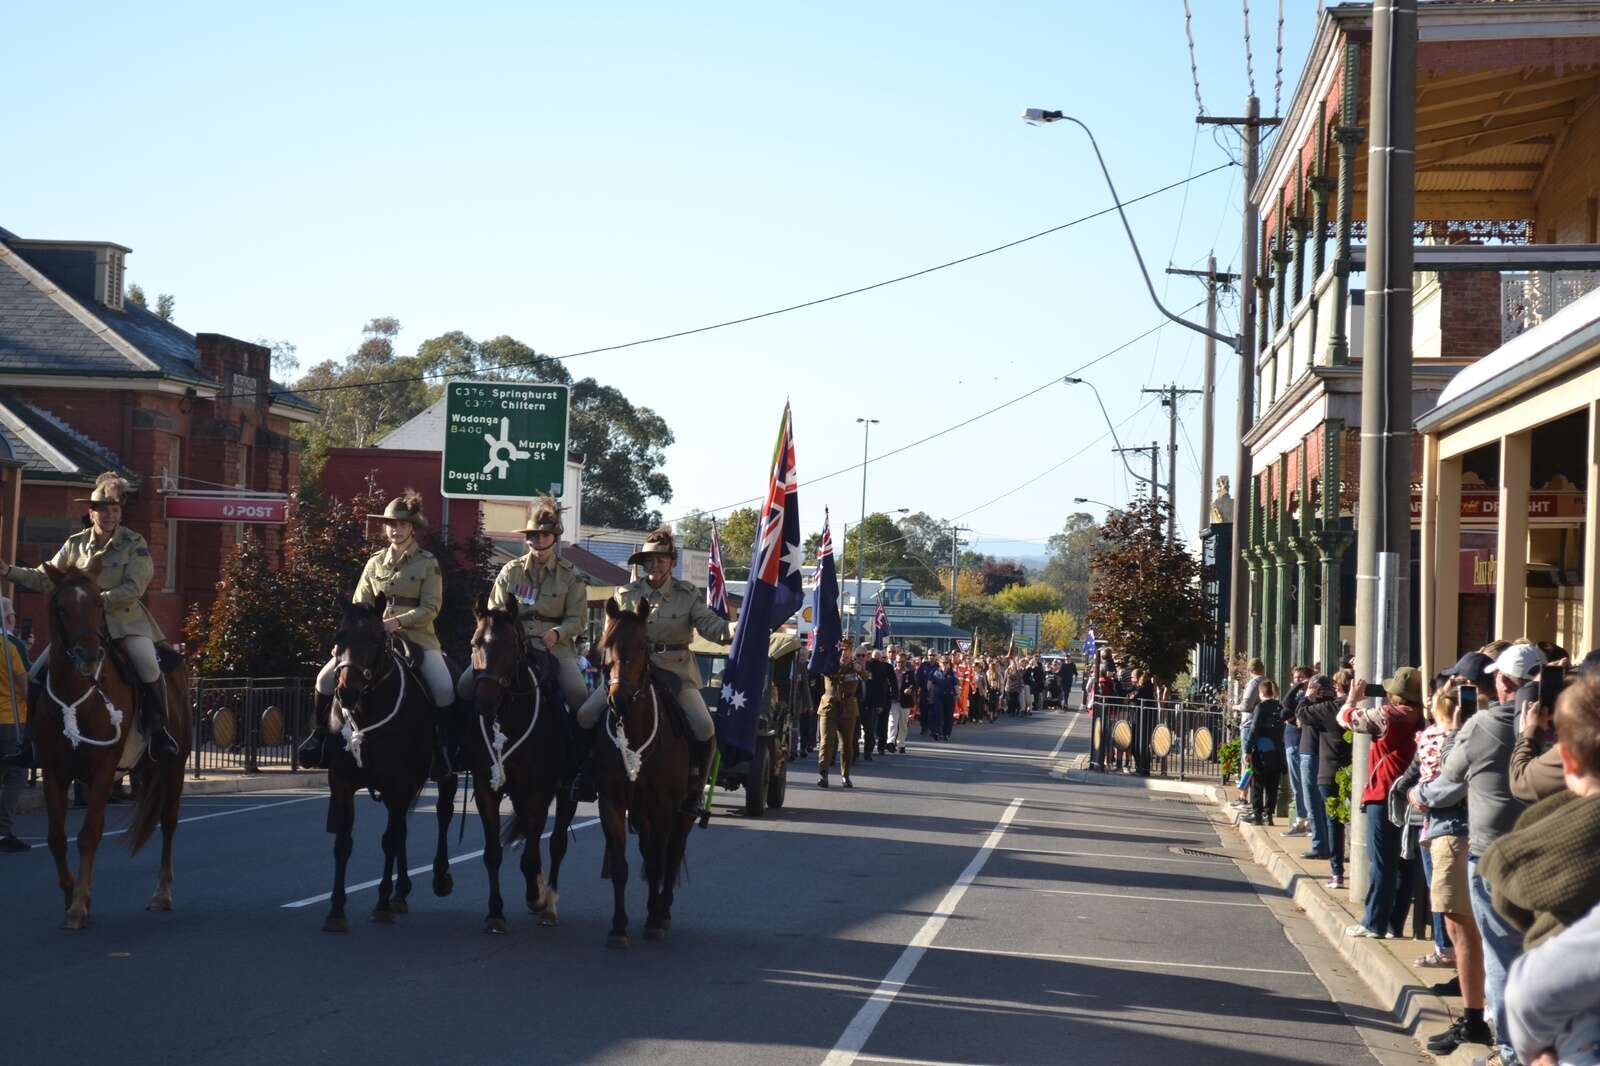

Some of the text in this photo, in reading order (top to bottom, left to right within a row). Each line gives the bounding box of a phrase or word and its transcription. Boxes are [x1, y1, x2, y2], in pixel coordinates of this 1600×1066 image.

[455, 387, 558, 400] C376 Springhurst
[501, 400, 546, 411] Chiltern
[451, 413, 499, 426] Wodonga
[519, 439, 561, 451] Murphy
[533, 451, 546, 460] St
[448, 470, 492, 481] Douglas
[466, 482, 478, 491] St
[237, 506, 273, 517] POST
